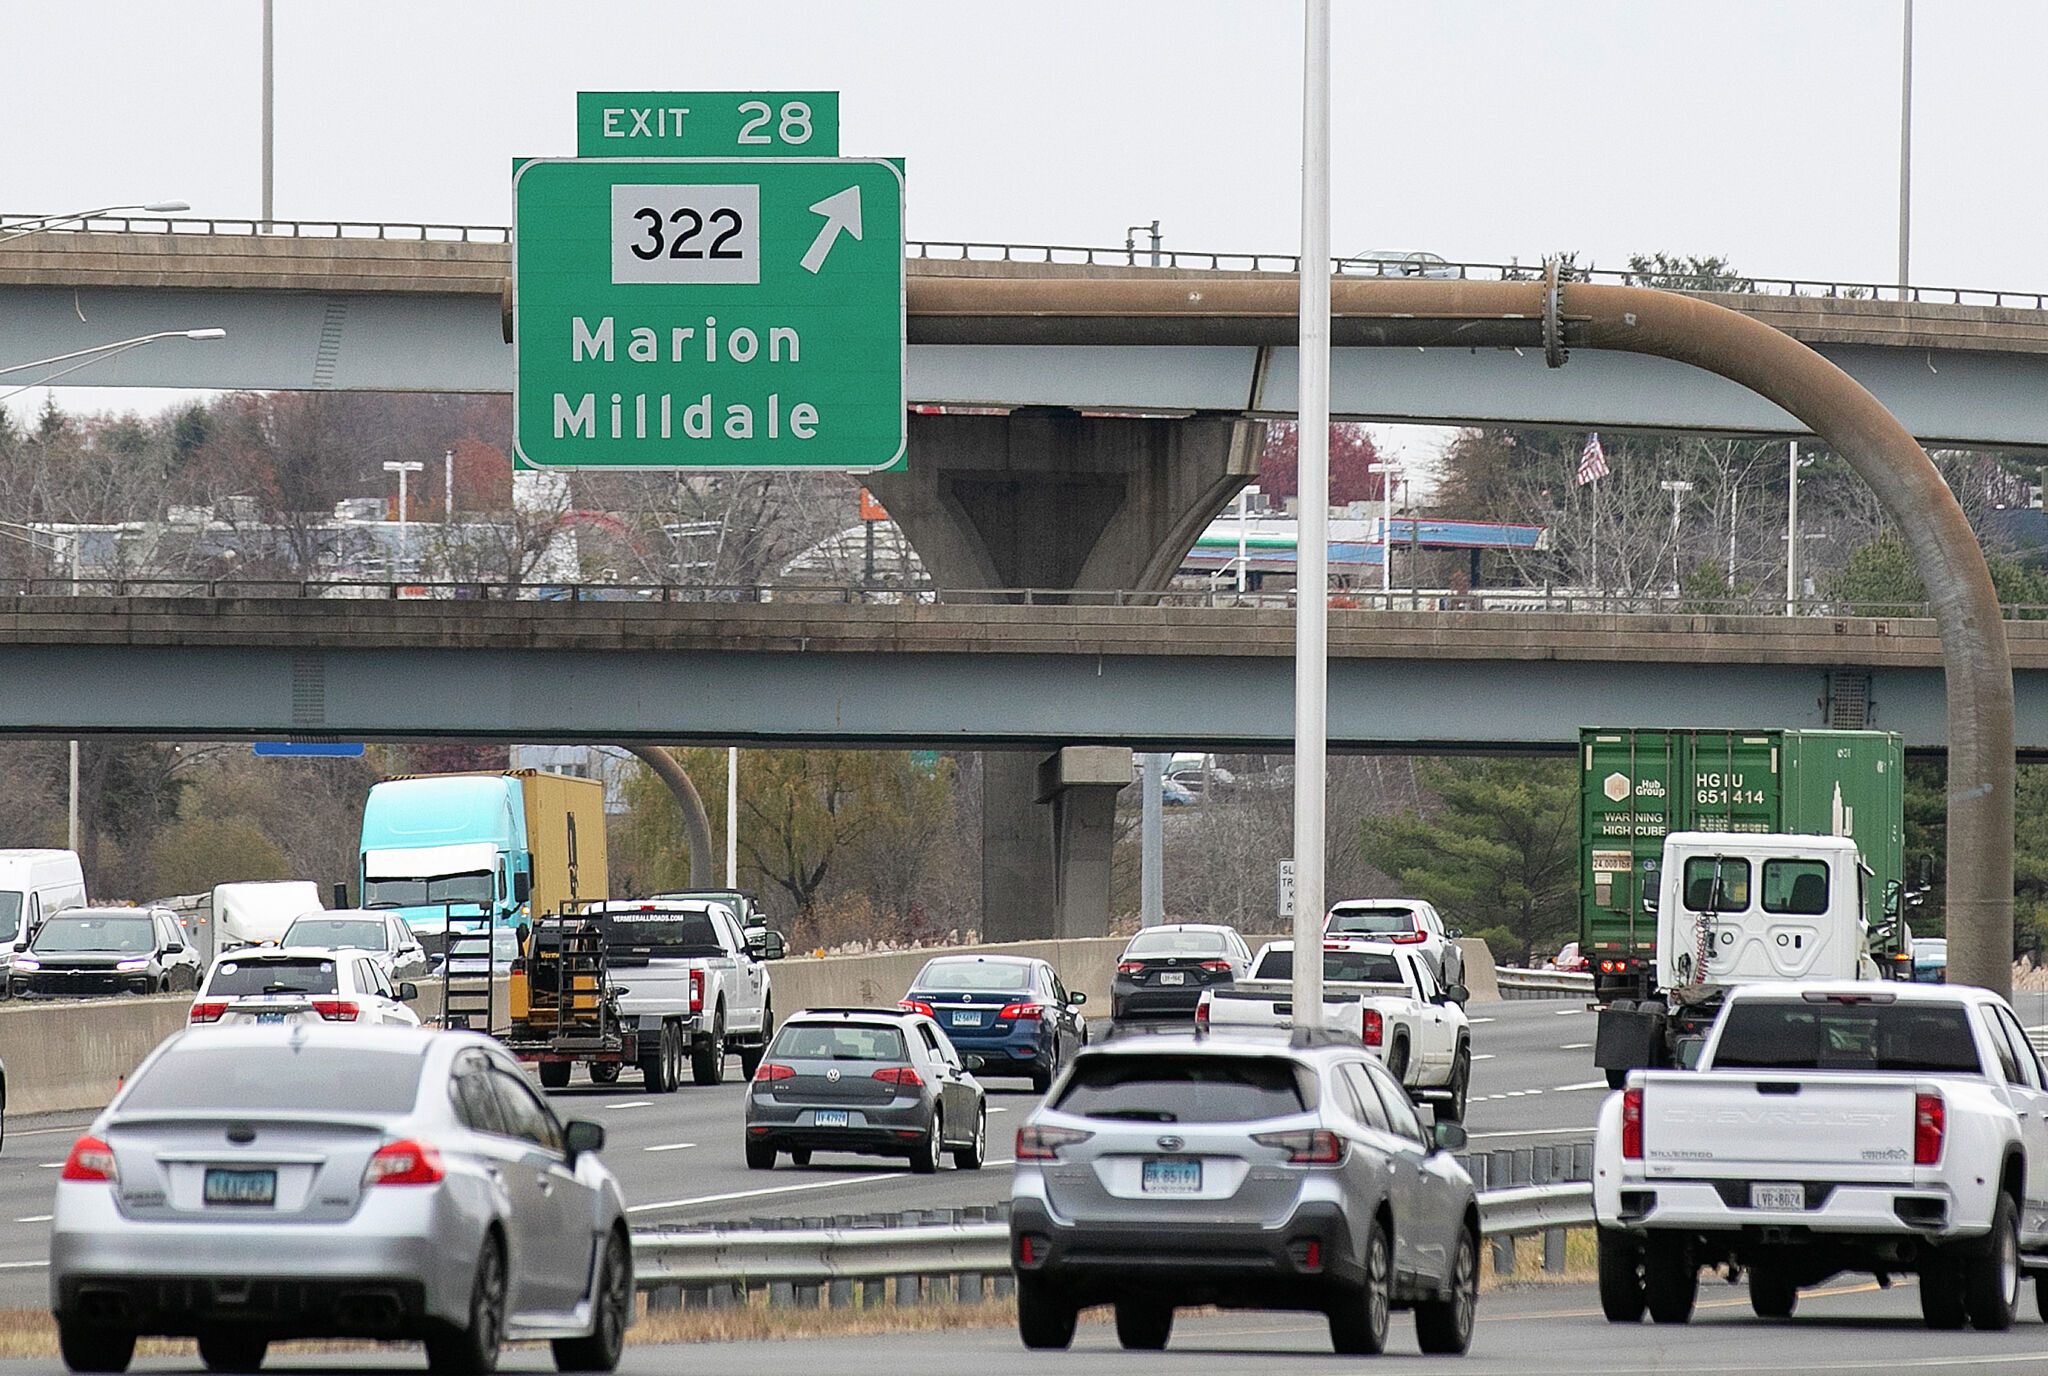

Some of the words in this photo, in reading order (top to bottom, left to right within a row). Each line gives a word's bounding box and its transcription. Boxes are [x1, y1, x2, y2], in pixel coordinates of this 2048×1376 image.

[603, 109, 690, 137] EXIT
[738, 101, 813, 145] 28
[630, 207, 743, 260] 322
[572, 316, 800, 361] Marion
[553, 393, 819, 438] Milldale
[1642, 780, 1661, 789] Hub
[1697, 773, 1743, 788] HGIU
[1635, 786, 1665, 798] Group
[1697, 790, 1764, 804] 651414
[1604, 812, 1663, 823] WARNING
[1603, 826, 1631, 835] HIGH
[1635, 826, 1666, 836] CUBE
[540, 951, 560, 959] Verm
